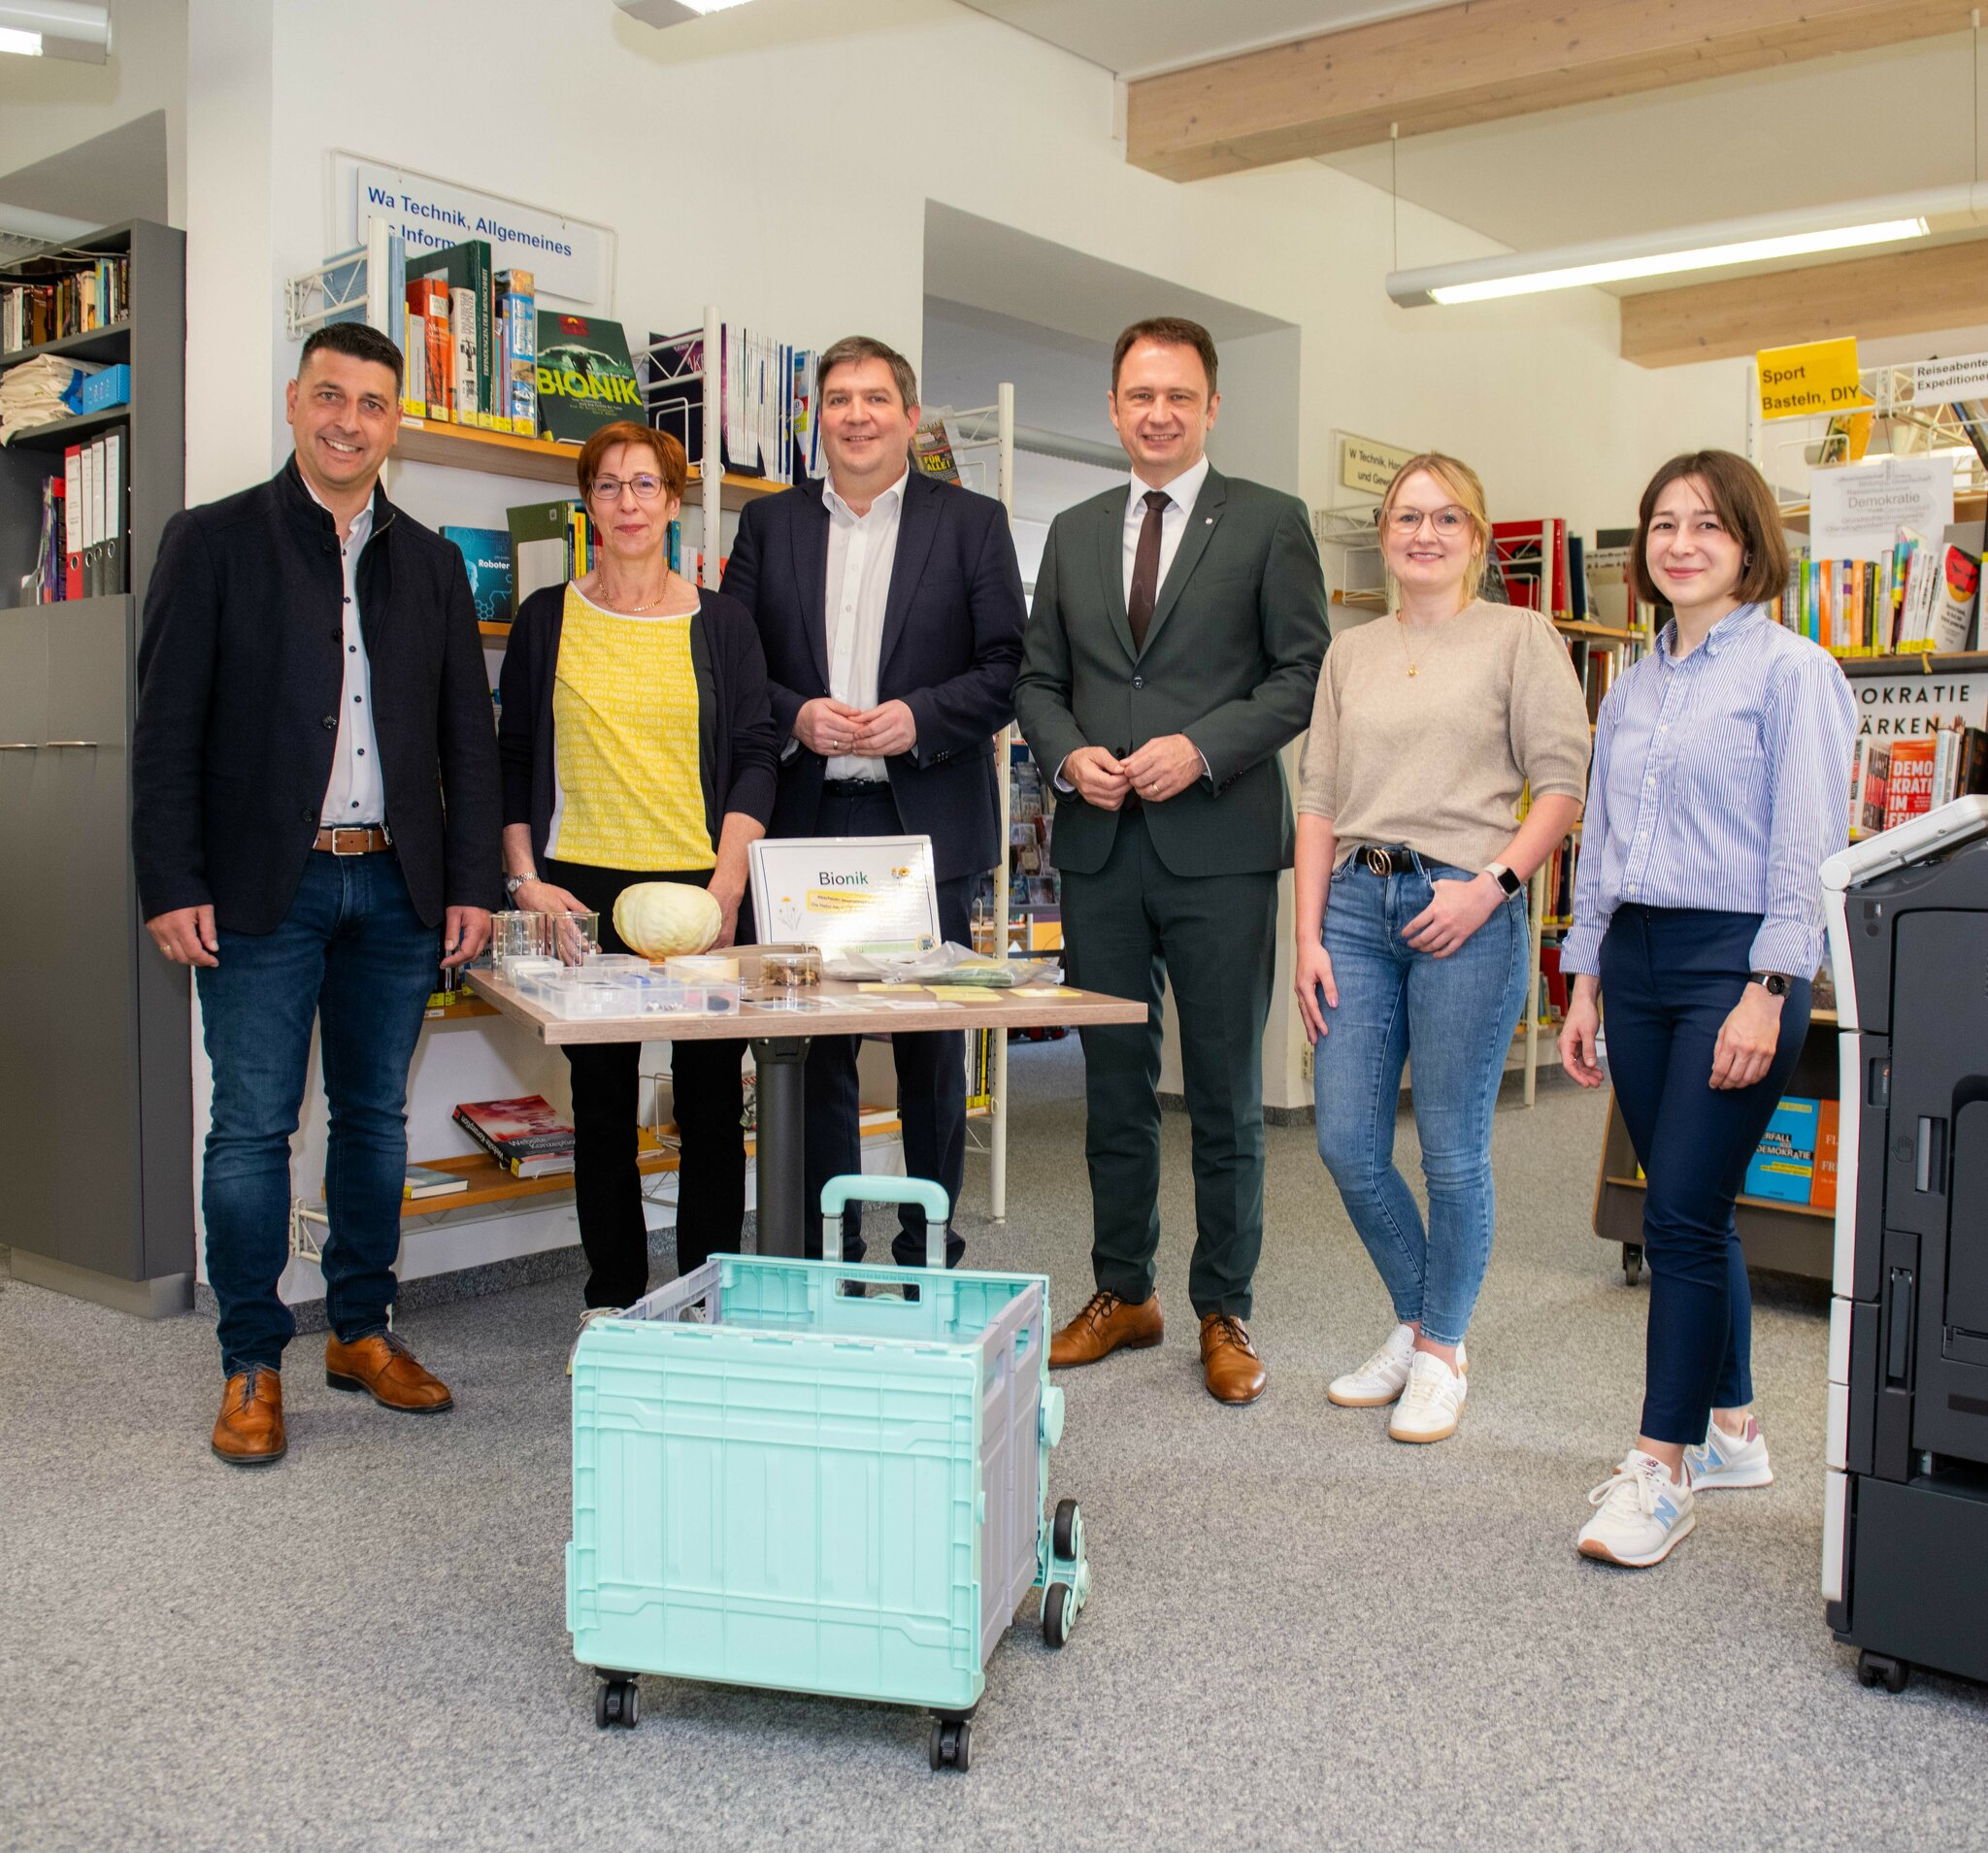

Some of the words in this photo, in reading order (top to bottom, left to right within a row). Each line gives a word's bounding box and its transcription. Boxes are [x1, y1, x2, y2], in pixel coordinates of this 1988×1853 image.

[368, 186, 395, 208] Wa
[401, 195, 472, 231] Technik,
[476, 216, 573, 257] Allgemeines
[1763, 366, 1806, 385] Sport
[1917, 359, 1988, 377] Reiseabente
[537, 367, 643, 406] BIONIK
[1762, 390, 1826, 411] Basteln,
[1832, 385, 1859, 402] DIY
[923, 454, 942, 464] FÜR
[1349, 447, 1357, 458] W
[1359, 450, 1386, 469] Technik,
[1358, 472, 1372, 481] und
[1848, 492, 1920, 509] Demokratie
[479, 558, 510, 570] Roboter
[1855, 684, 1971, 704] OKRATIE
[1859, 714, 1939, 735] ÄRKEN
[1894, 760, 1934, 777] DEMO
[1892, 778, 1932, 794] KRATI
[1890, 795, 1907, 811] IM
[819, 871, 869, 885] Bionik
[528, 1140, 575, 1149] Konzeptio
[1826, 1134, 1839, 1145] FL
[1757, 1144, 1811, 1160] DEMOKRATIE
[1822, 1160, 1838, 1172] FR
